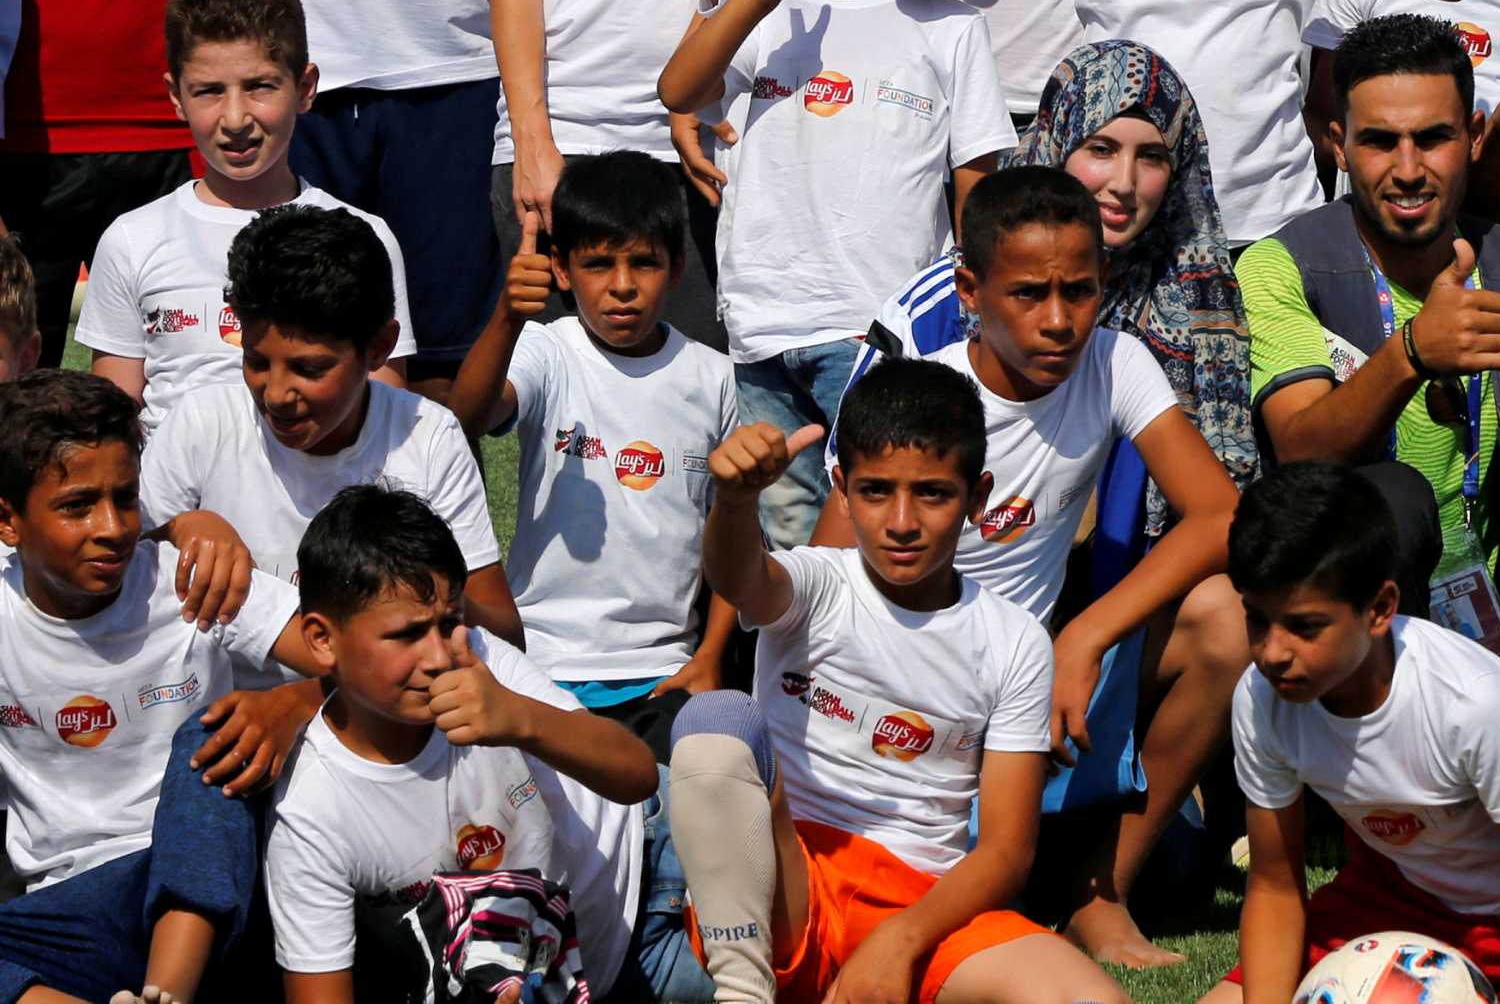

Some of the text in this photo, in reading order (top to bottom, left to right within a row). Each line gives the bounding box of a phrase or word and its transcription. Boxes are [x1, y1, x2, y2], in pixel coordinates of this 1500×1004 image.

[805, 81, 833, 101] Lay's
[1332, 347, 1356, 365] ASIAN
[615, 452, 644, 473] Lay's
[140, 676, 199, 707] FOUNDATION
[814, 687, 841, 704] ASIAN
[57, 710, 87, 733] Lay's
[874, 721, 910, 746] Lay's
